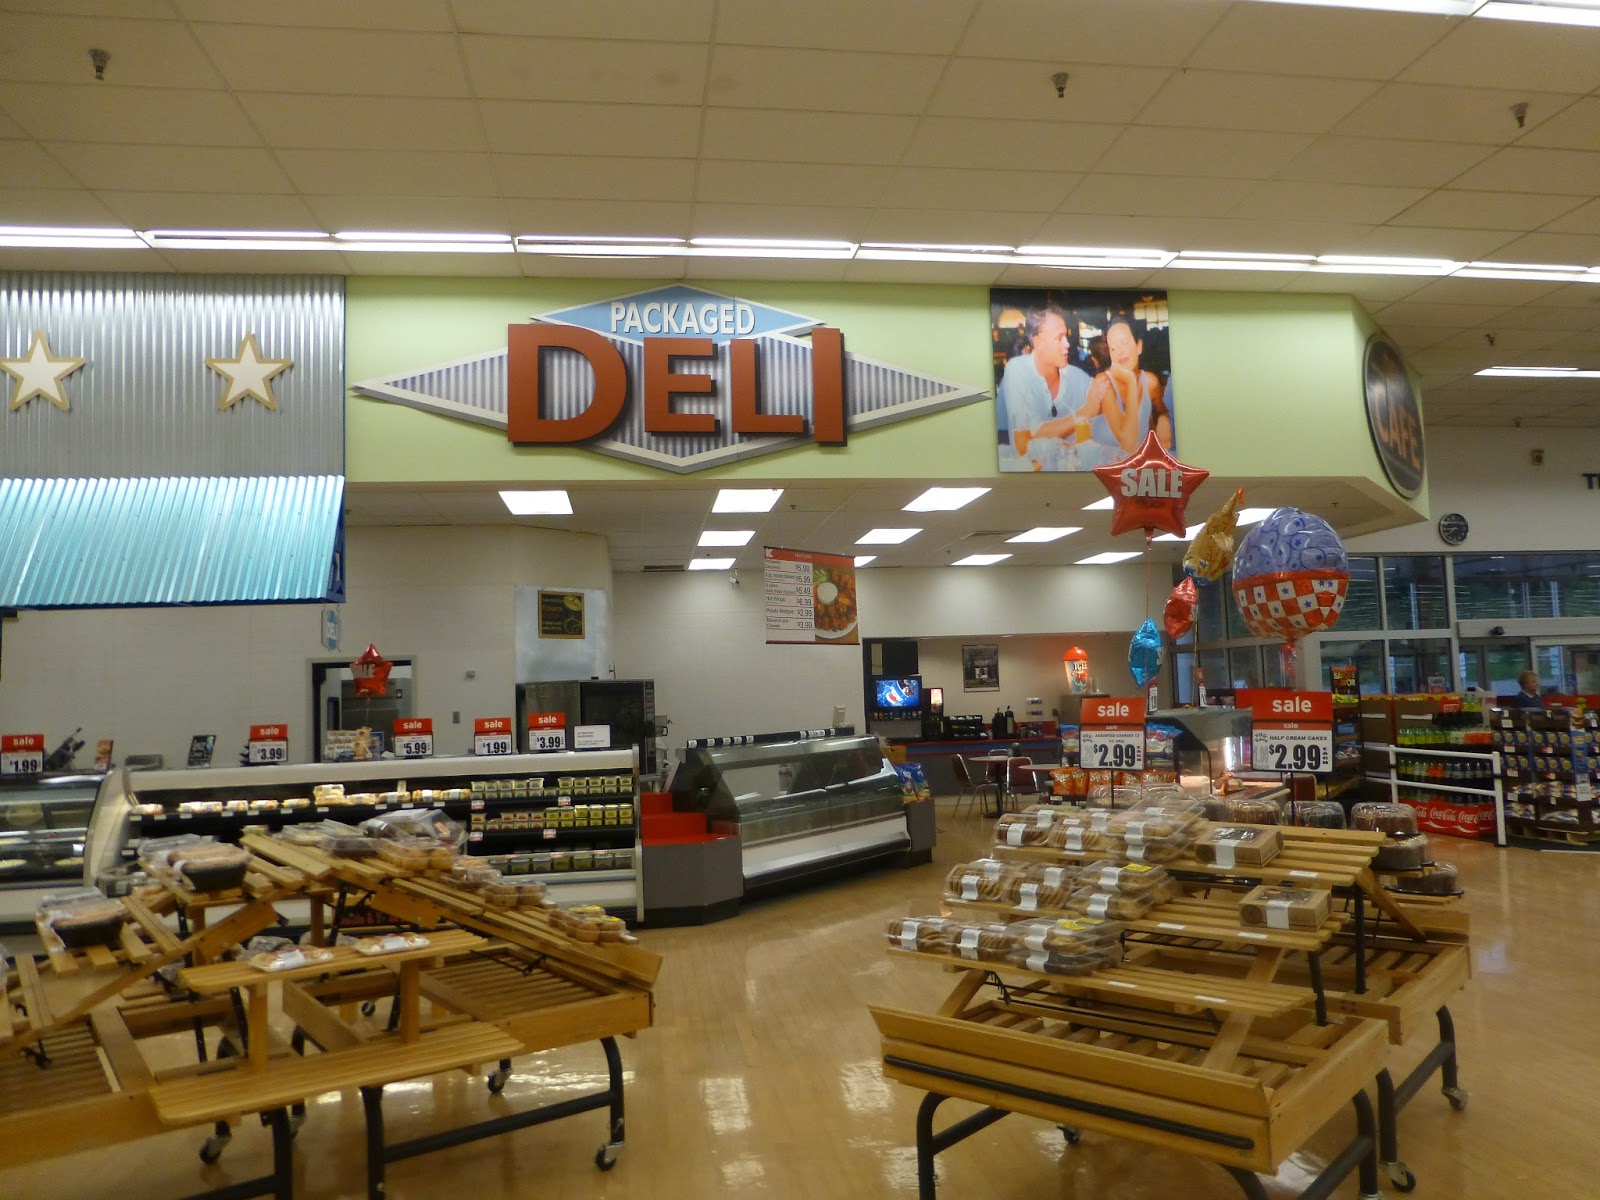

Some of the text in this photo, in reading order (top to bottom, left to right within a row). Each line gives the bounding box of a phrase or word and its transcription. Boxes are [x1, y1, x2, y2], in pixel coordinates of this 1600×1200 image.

[610, 302, 755, 335] PACKAGED
[508, 324, 846, 444] DELI
[1121, 468, 1183, 498] SALE
[1098, 701, 1129, 717] sale
[1272, 695, 1312, 713] sale
[403, 720, 422, 729] sale
[484, 720, 503, 728] sale
[538, 715, 557, 724] sale
[260, 727, 279, 736] sale
[13, 736, 34, 746] sale
[537, 736, 560, 748] $3.99
[403, 742, 426, 754] $5.99
[483, 741, 506, 754] $1.99
[257, 748, 282, 760] $3.99
[1093, 743, 1135, 767] $2.99
[1269, 744, 1321, 770] $2.99
